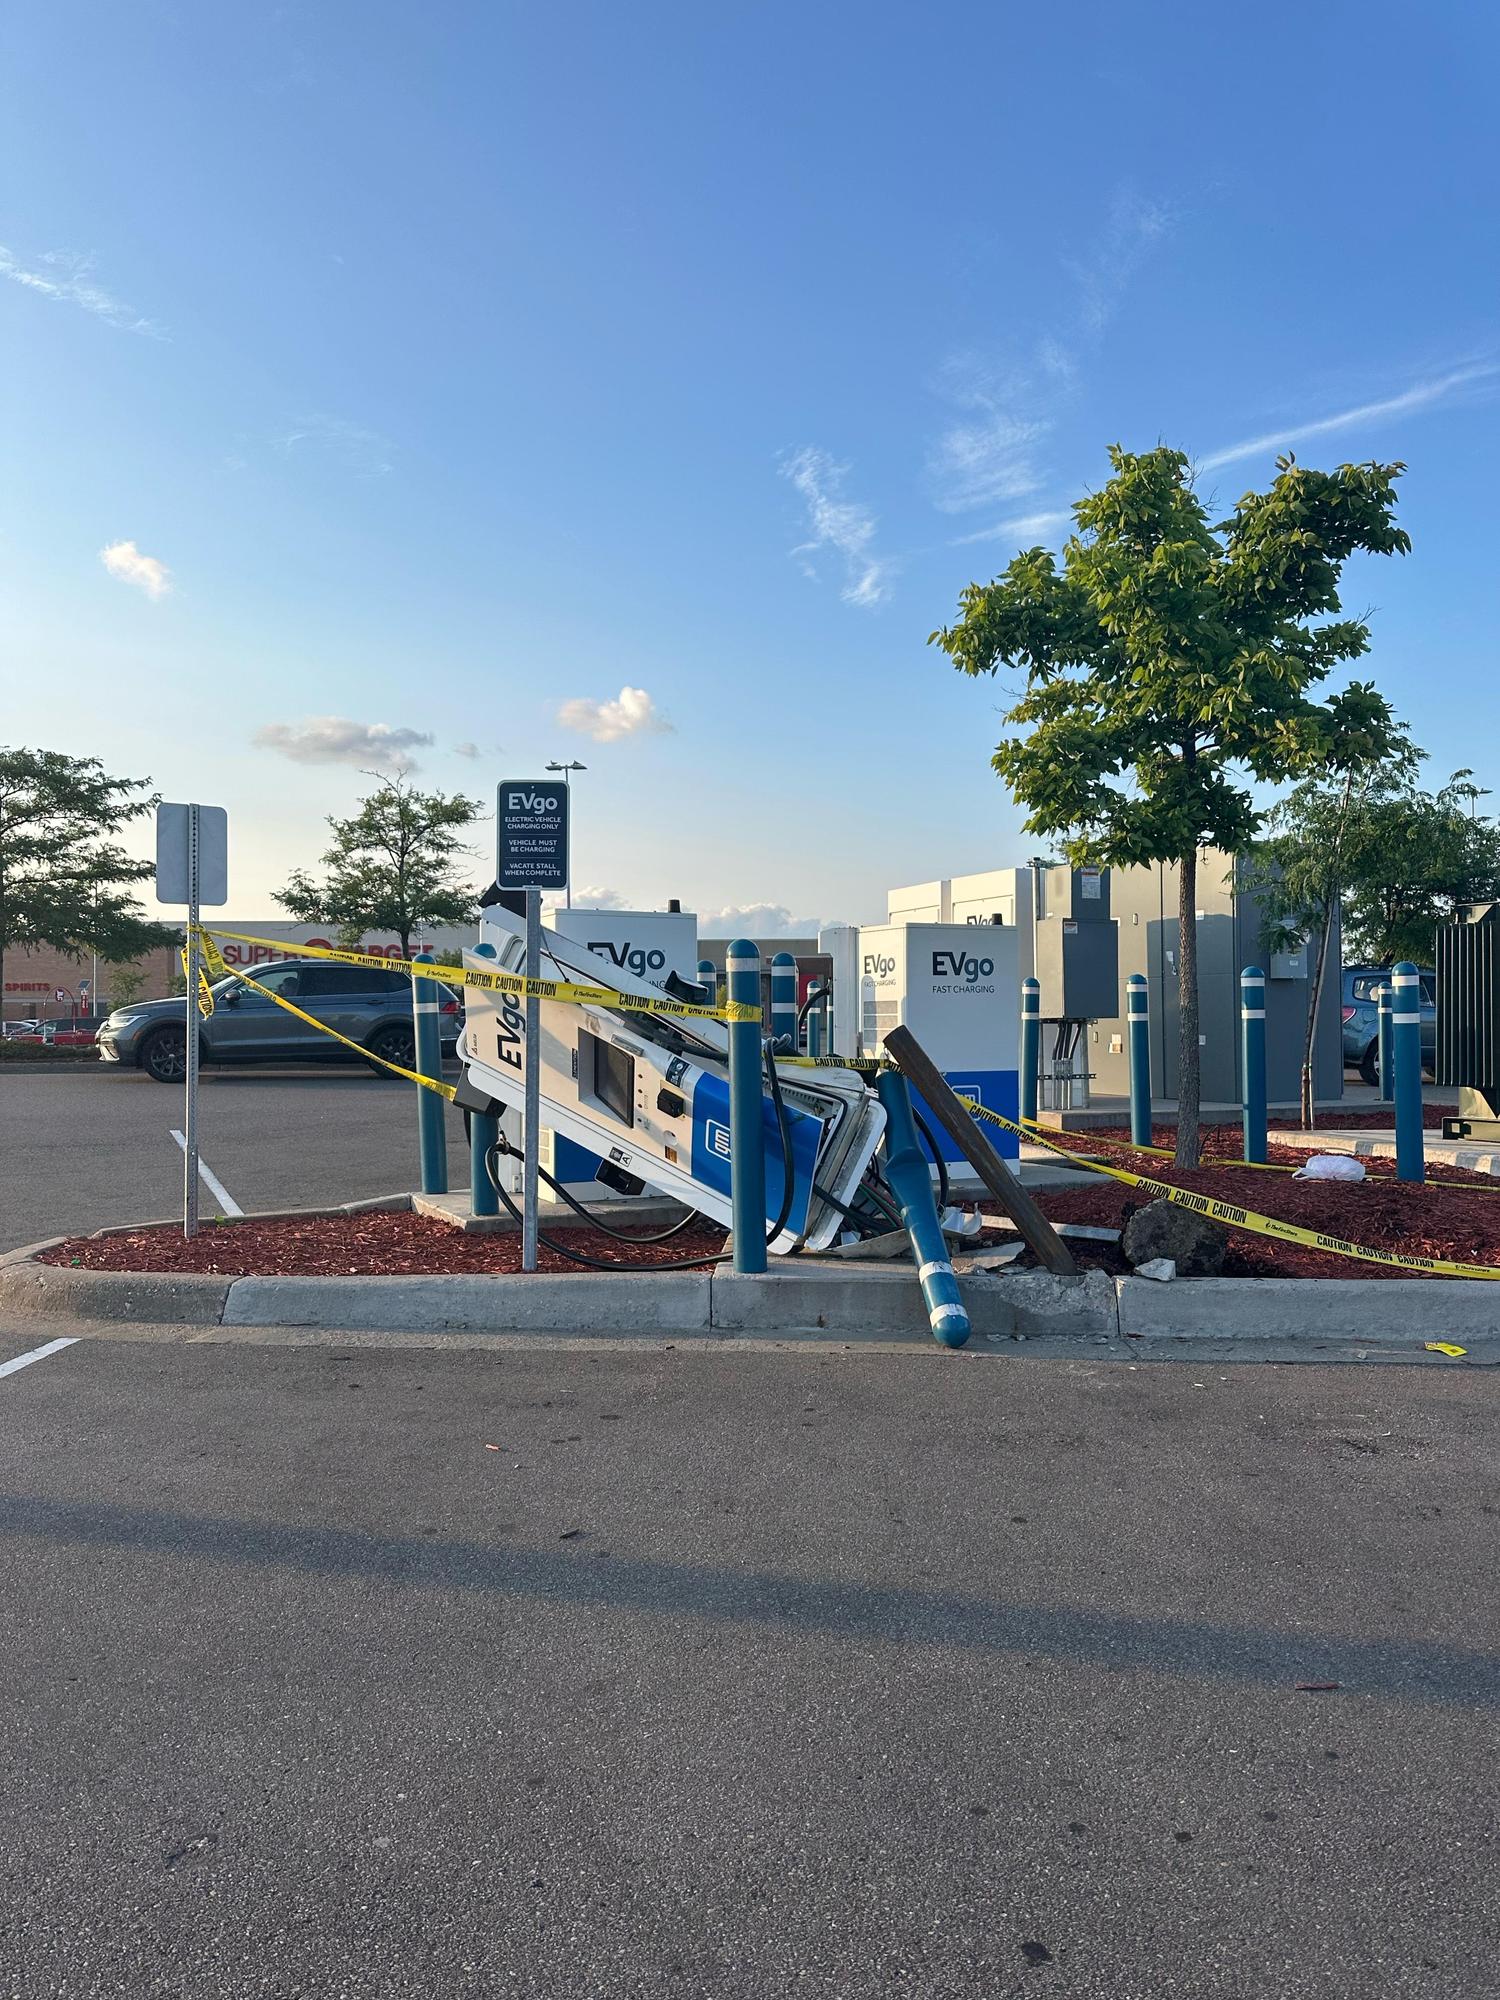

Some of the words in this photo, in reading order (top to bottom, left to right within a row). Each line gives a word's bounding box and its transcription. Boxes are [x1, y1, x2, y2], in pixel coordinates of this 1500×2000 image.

[508, 793, 558, 814] EVgo
[864, 954, 896, 978] EVgo
[932, 952, 994, 983] EVgo
[5, 983, 50, 992] SPIRITS
[465, 971, 493, 988] CAUTION
[495, 977, 523, 993] CAUTION
[526, 981, 557, 997] CAUTION
[619, 993, 649, 1009] CAUTION
[653, 1000, 684, 1013] CAUTION
[932, 985, 951, 993] FAST
[953, 985, 994, 993] CHARGING
[496, 993, 525, 1070] EVgo
[815, 1058, 846, 1067] CAUTION
[849, 1059, 881, 1068] CAUTION
[969, 1104, 1001, 1126] CAUTION
[1004, 1123, 1035, 1143] CAUTION
[622, 1155, 630, 1164] A
[1136, 1179, 1172, 1199] CAUTION
[1174, 1190, 1209, 1212] CAUTION
[1212, 1202, 1247, 1224] CAUTION
[1317, 1235, 1352, 1252] CAUTION
[1357, 1247, 1393, 1261] CAUTION
[1398, 1255, 1434, 1268] CAUTION
